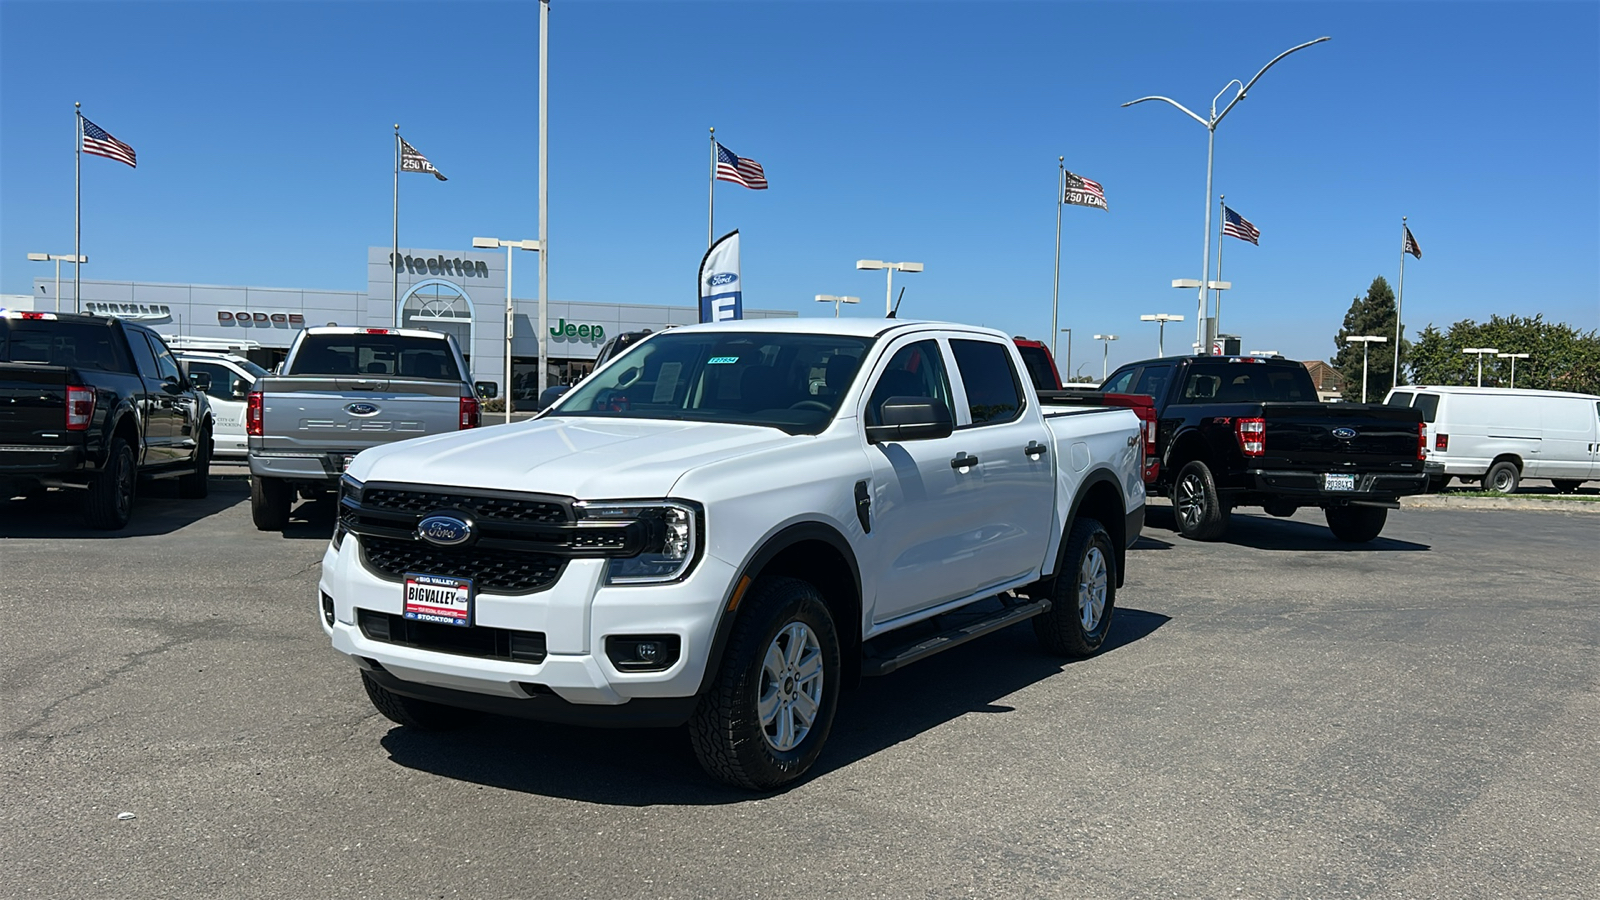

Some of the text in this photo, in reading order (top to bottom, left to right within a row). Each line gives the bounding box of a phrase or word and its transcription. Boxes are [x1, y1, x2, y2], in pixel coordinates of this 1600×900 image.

[403, 158, 420, 169] 250
[1065, 192, 1082, 203] 250
[389, 252, 488, 277] Stockton
[711, 274, 732, 285] Ford
[217, 311, 304, 324] DODGE
[549, 318, 604, 341] Jeep
[428, 521, 457, 538] Ford
[432, 578, 454, 586] VALLEY
[408, 586, 456, 606] BIGVALLEY
[417, 613, 454, 624] STOCKTON
